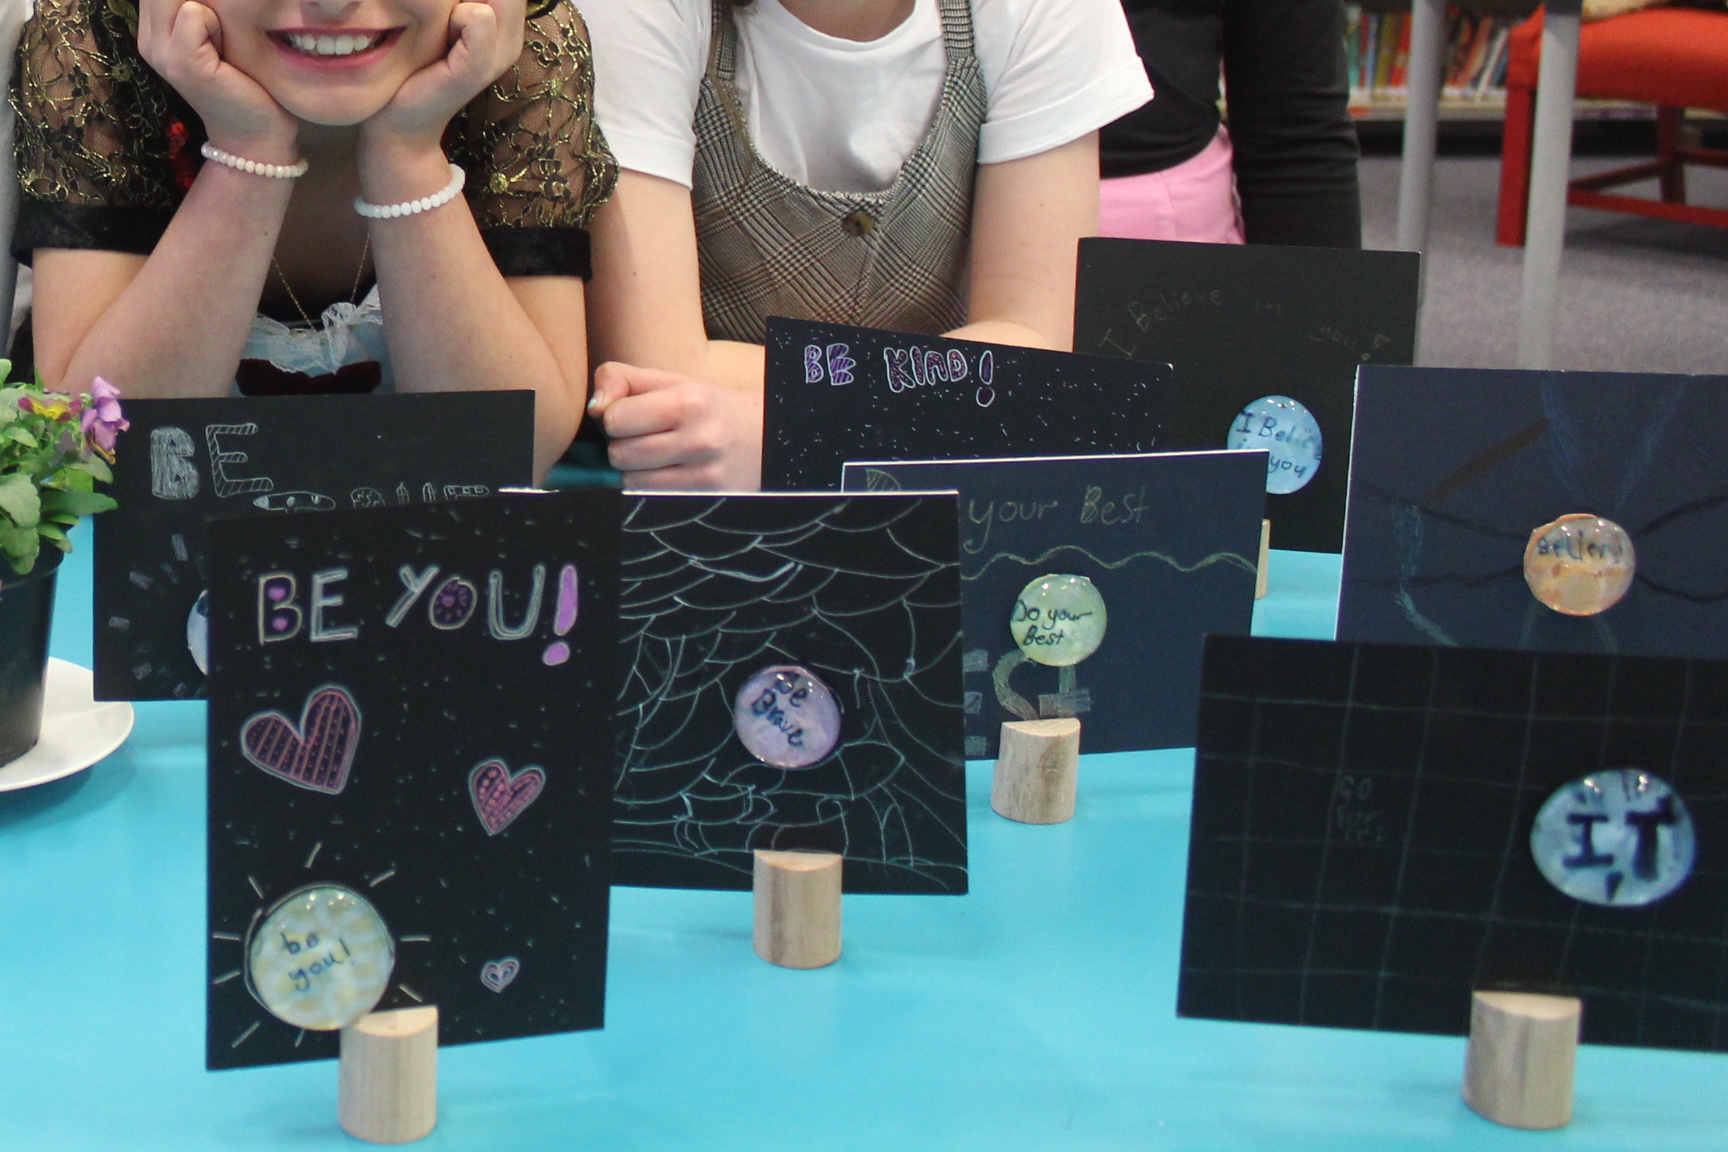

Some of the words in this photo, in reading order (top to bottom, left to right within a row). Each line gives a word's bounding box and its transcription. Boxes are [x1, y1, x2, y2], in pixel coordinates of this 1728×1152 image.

[804, 342, 857, 386] BE
[1235, 410, 1254, 434] I
[150, 422, 274, 500] BE
[963, 499, 1058, 554] your
[1079, 485, 1150, 525] Best
[259, 562, 360, 646] BE
[384, 563, 579, 667] YOU!
[1046, 605, 1093, 630] your
[751, 688, 804, 746] Brave
